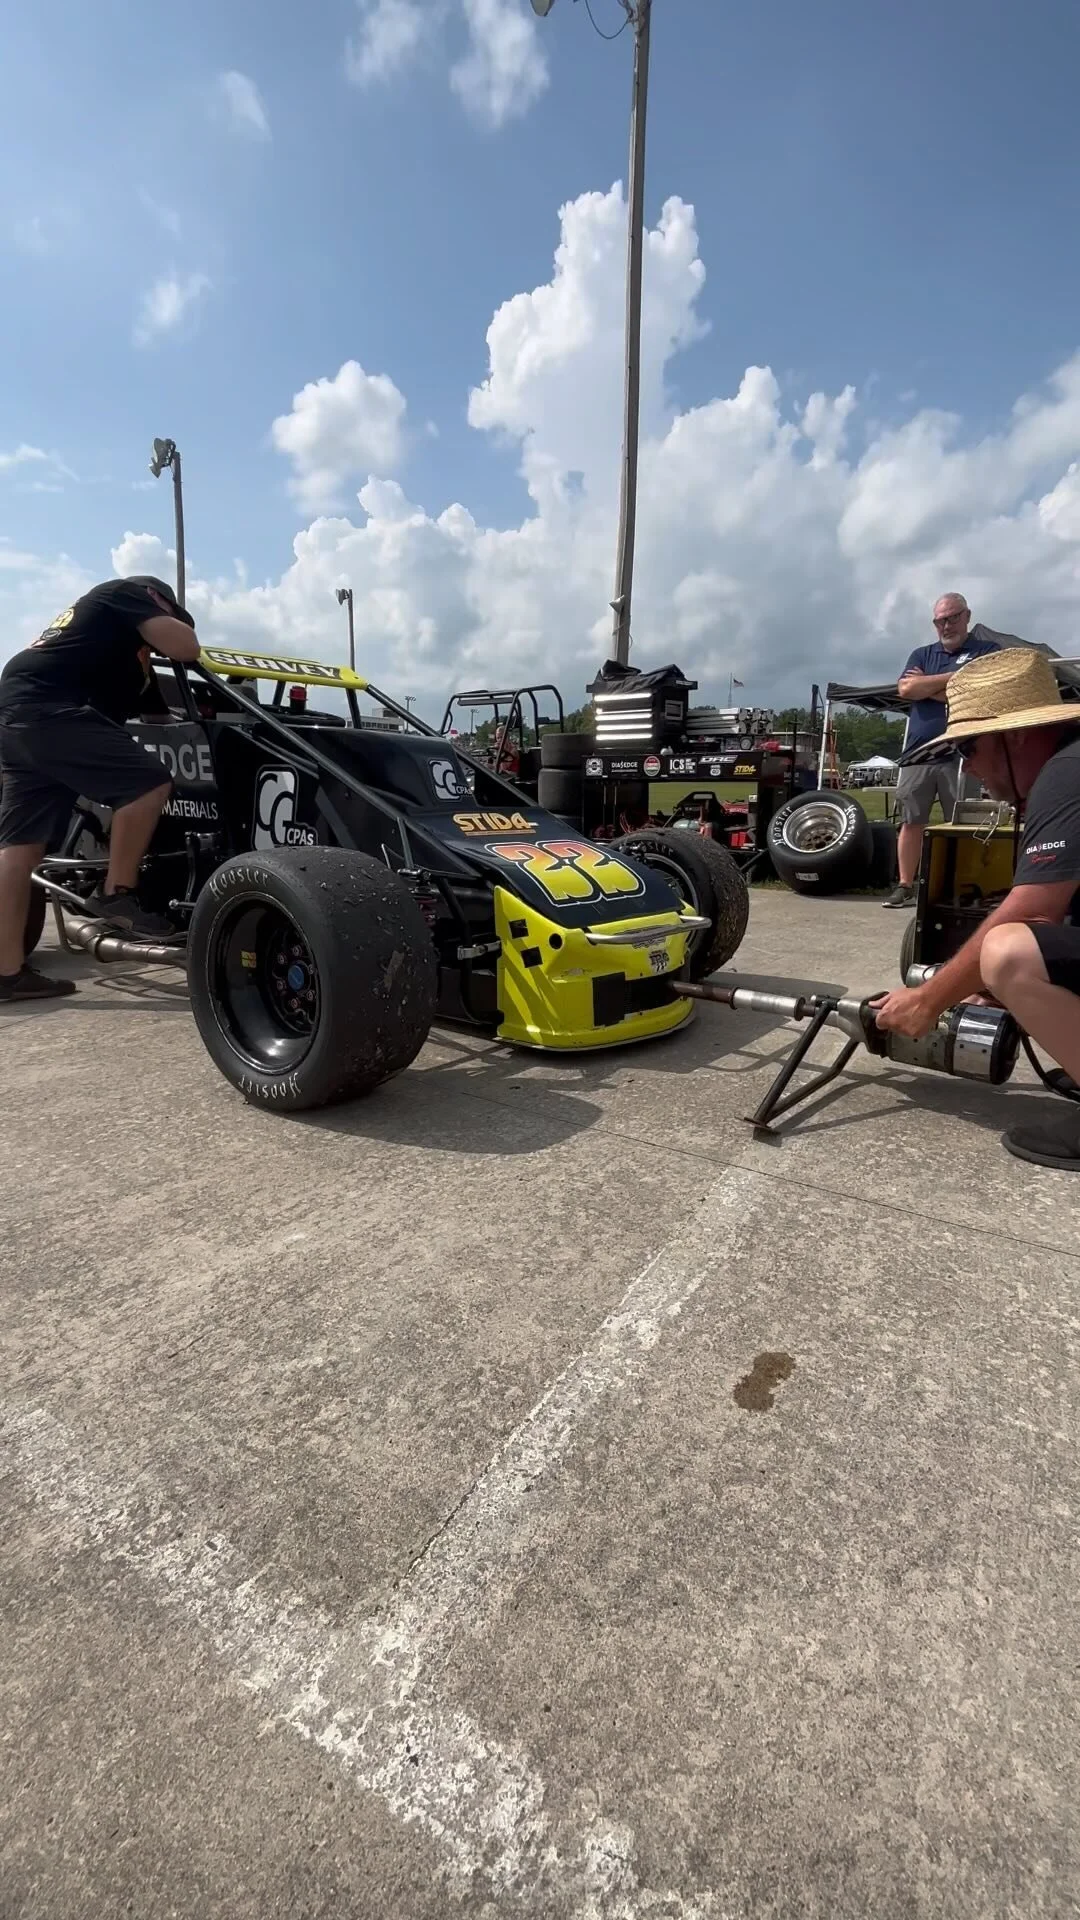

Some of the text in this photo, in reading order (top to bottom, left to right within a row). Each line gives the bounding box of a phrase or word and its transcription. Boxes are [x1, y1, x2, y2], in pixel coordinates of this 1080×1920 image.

[207, 651, 336, 678] SEAVEY
[669, 759, 685, 771] ICS
[161, 799, 219, 820] MATERIALS
[453, 813, 532, 832] STIDA
[286, 828, 315, 846] CPAs
[486, 840, 645, 906] 22
